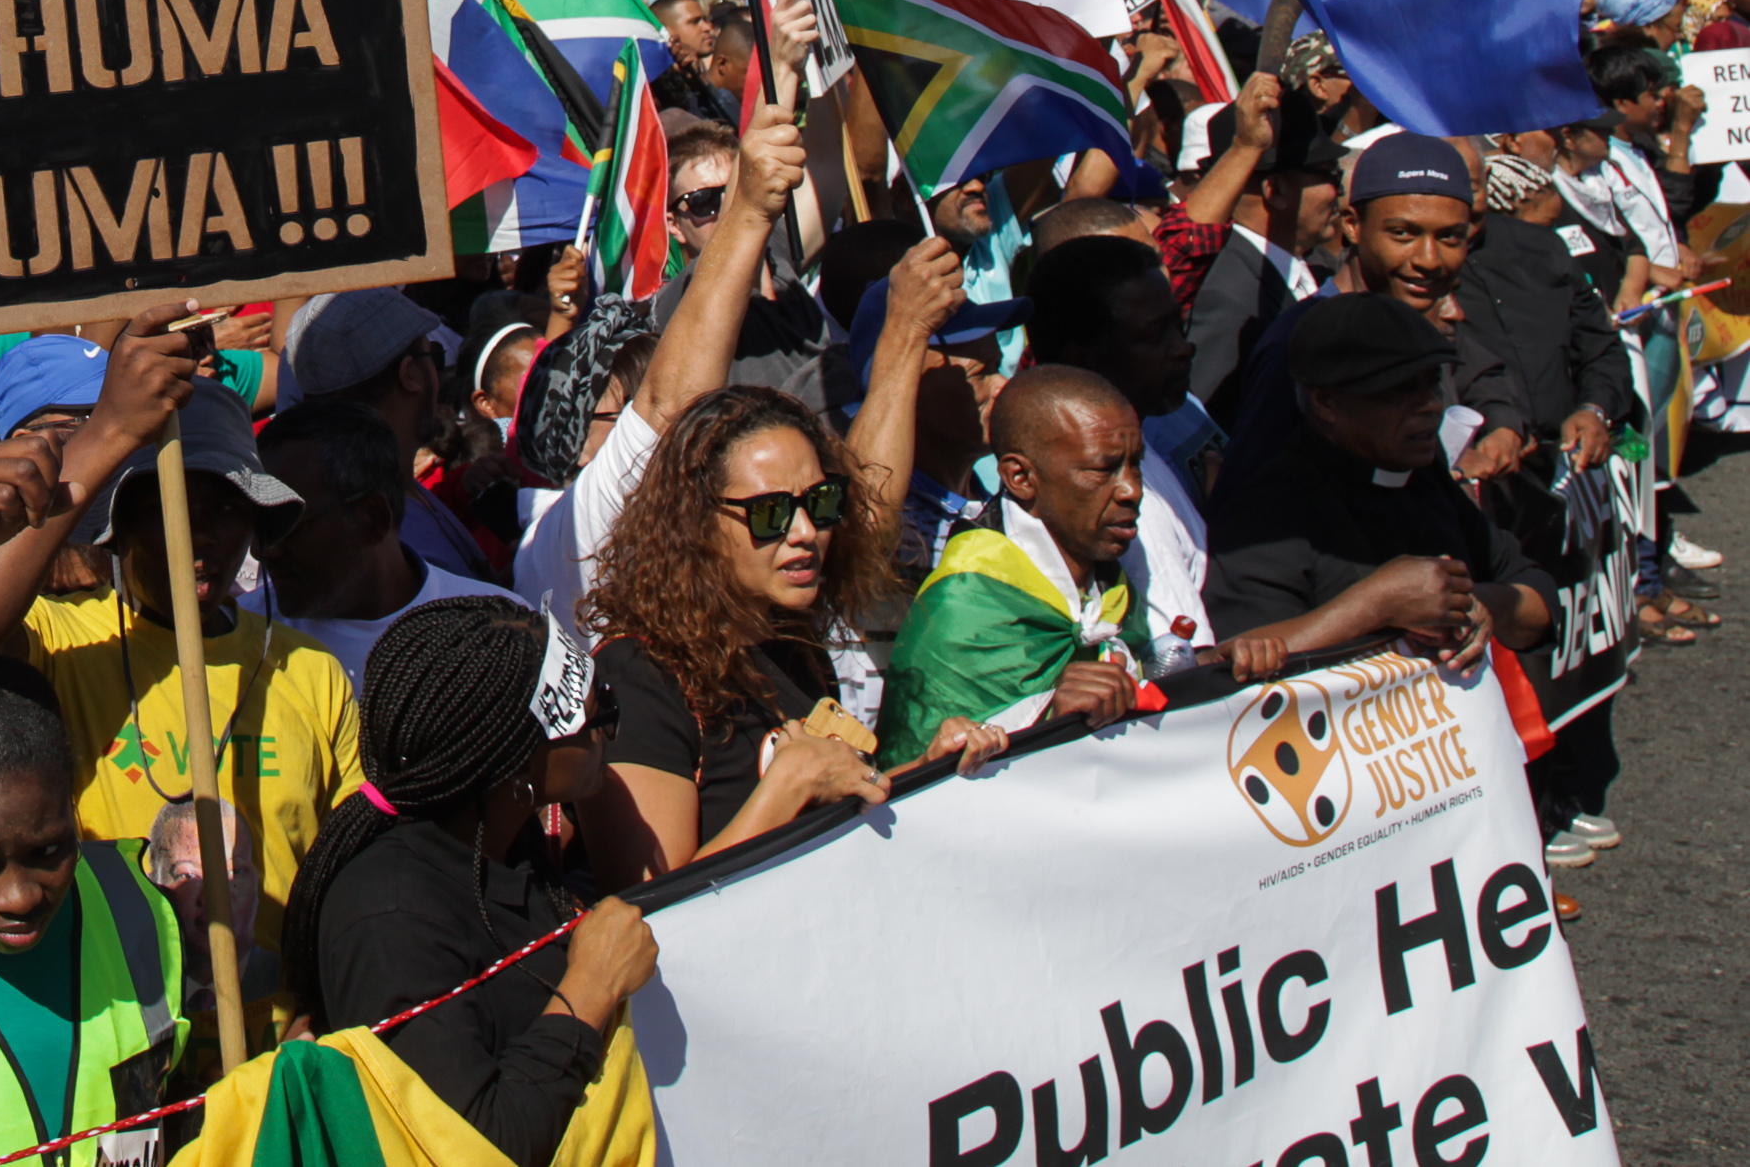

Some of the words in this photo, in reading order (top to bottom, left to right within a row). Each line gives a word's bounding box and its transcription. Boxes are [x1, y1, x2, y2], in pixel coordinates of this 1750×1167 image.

[166, 731, 281, 778] VTE
[1342, 671, 1456, 755] GENDER
[1366, 724, 1477, 819] JUSTICE
[1258, 862, 1305, 890] HIV/AIDS
[1313, 841, 1355, 867] GENDER
[1356, 820, 1404, 850] EQUALITY
[1410, 801, 1448, 825] HUMAN
[1448, 785, 1484, 810] RIGHTS
[928, 944, 1332, 1167] Public
